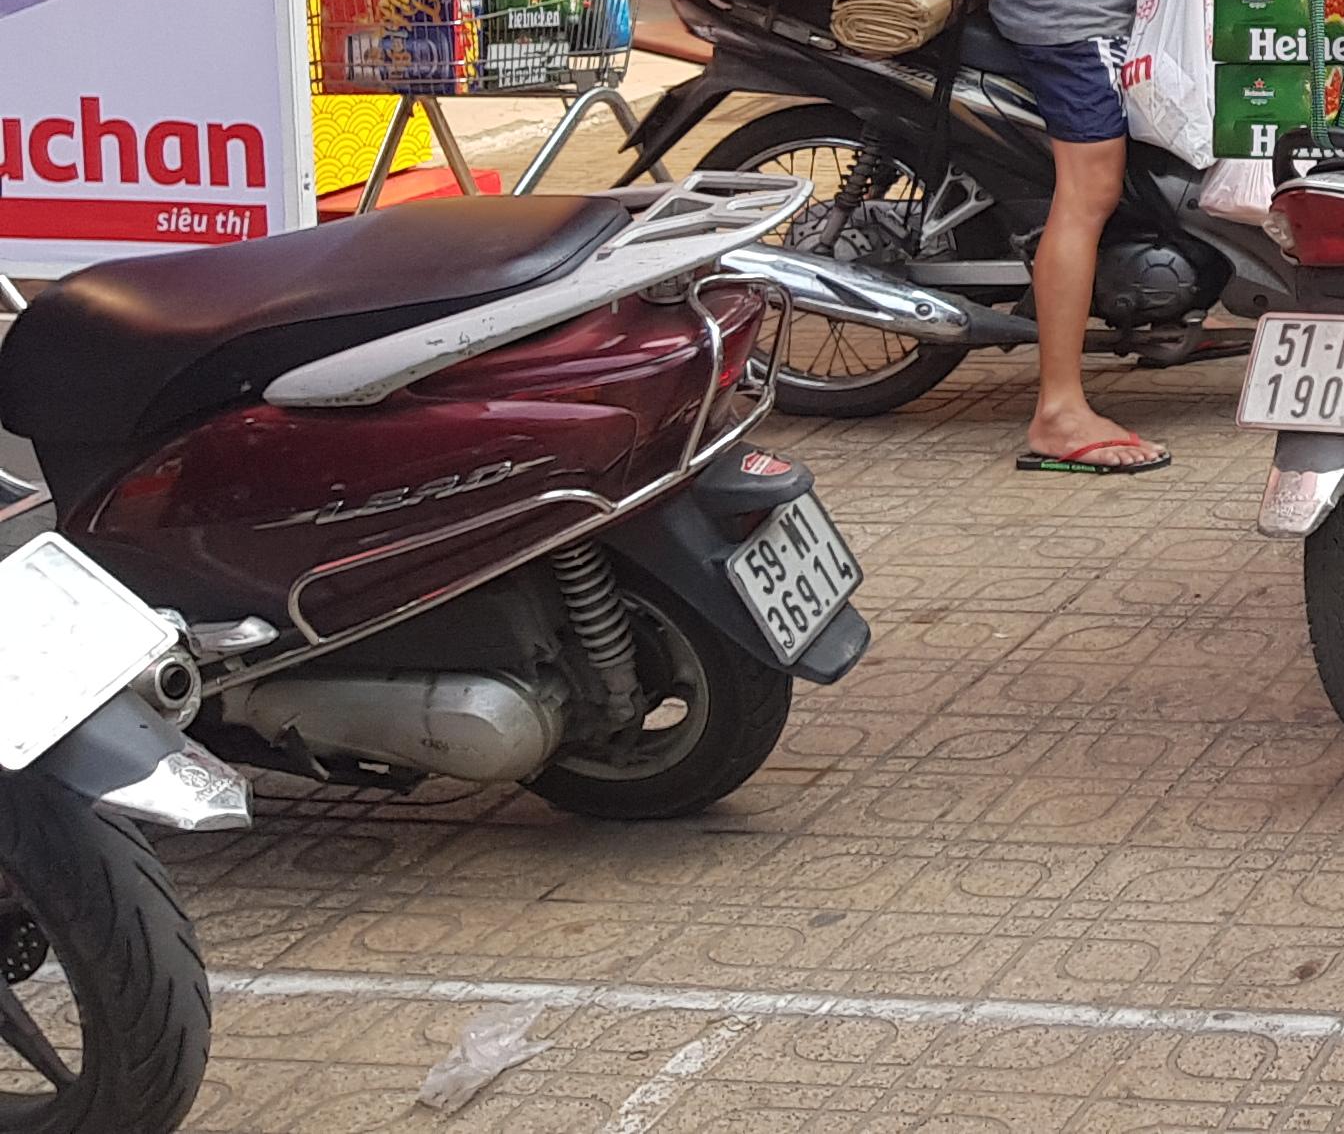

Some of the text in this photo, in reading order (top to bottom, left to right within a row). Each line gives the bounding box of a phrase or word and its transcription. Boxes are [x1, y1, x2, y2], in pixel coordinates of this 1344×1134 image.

[157, 203, 251, 240] siêu thị
[767, 541, 853, 649] 369.14
